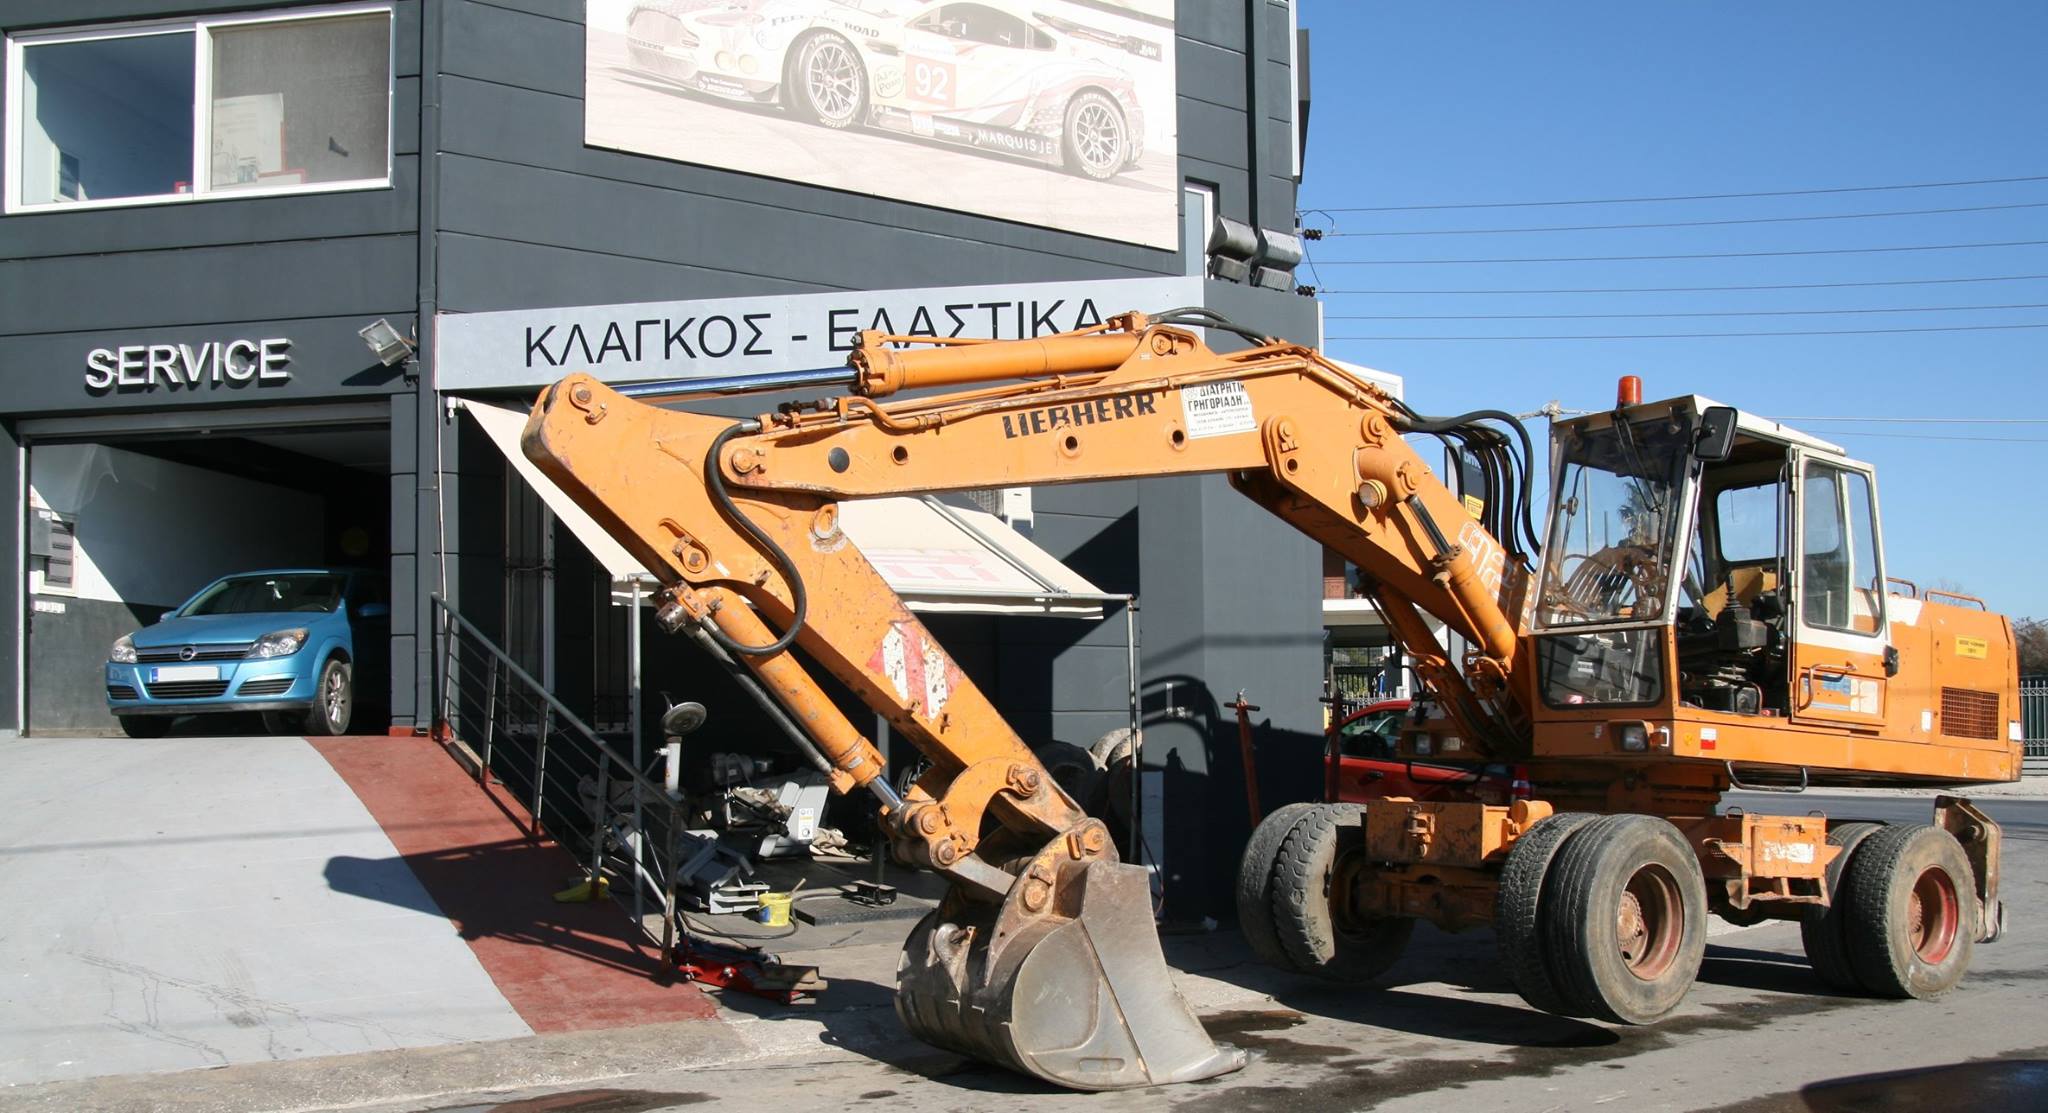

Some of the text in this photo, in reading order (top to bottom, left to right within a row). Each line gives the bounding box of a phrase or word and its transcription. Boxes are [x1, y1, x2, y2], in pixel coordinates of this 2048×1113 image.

[914, 62, 949, 101] 92
[977, 130, 1059, 155] MARQUIS JET
[525, 313, 773, 367] ΚΛΑΓΚΟΣ
[829, 298, 1105, 351] ΕΛΑΣΤΙΚΑ
[85, 337, 291, 391] SERVICE
[1002, 391, 1157, 439] LIEBHERR
